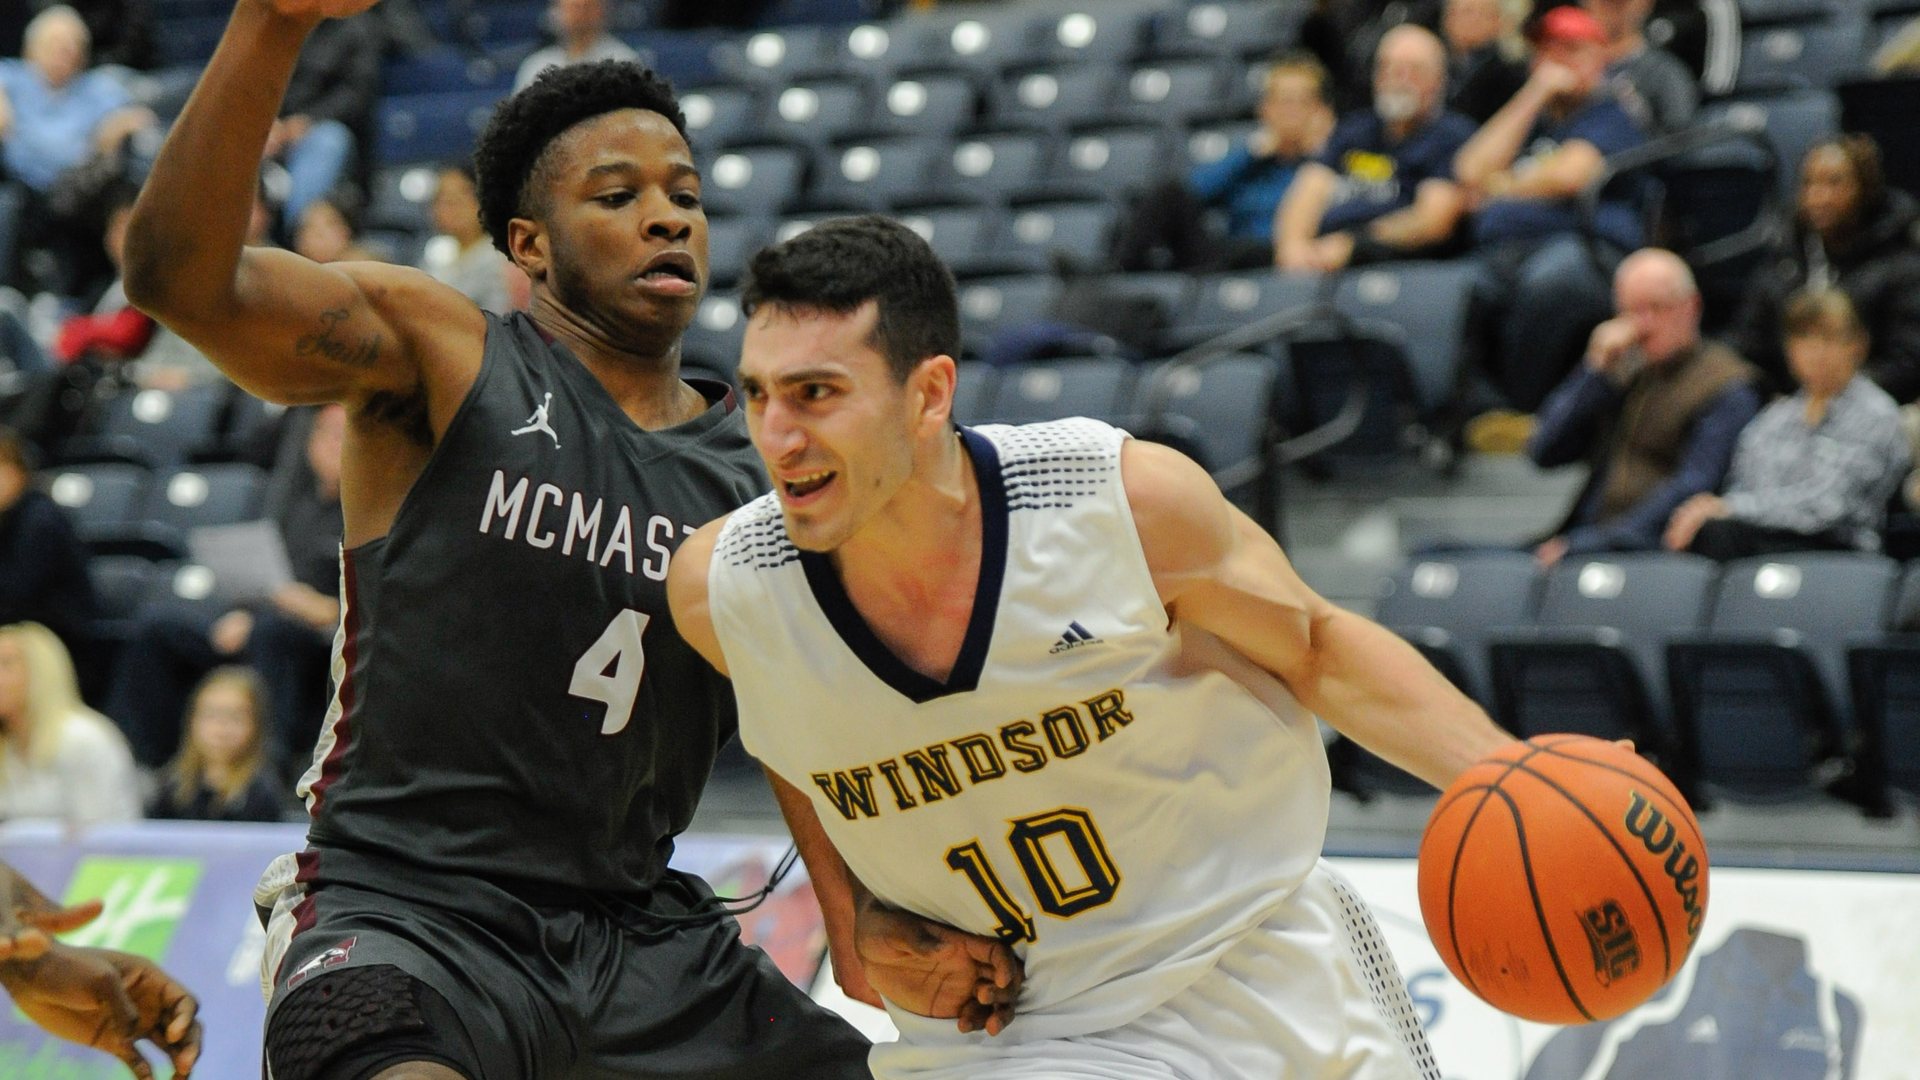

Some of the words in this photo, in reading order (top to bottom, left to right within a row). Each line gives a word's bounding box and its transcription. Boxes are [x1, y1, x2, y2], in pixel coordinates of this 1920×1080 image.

[479, 469, 700, 581] MCMAS
[567, 607, 651, 735] 4
[812, 687, 1134, 821] WINDSOR
[942, 807, 1124, 946] 10
[1623, 788, 1703, 938] Wilso
